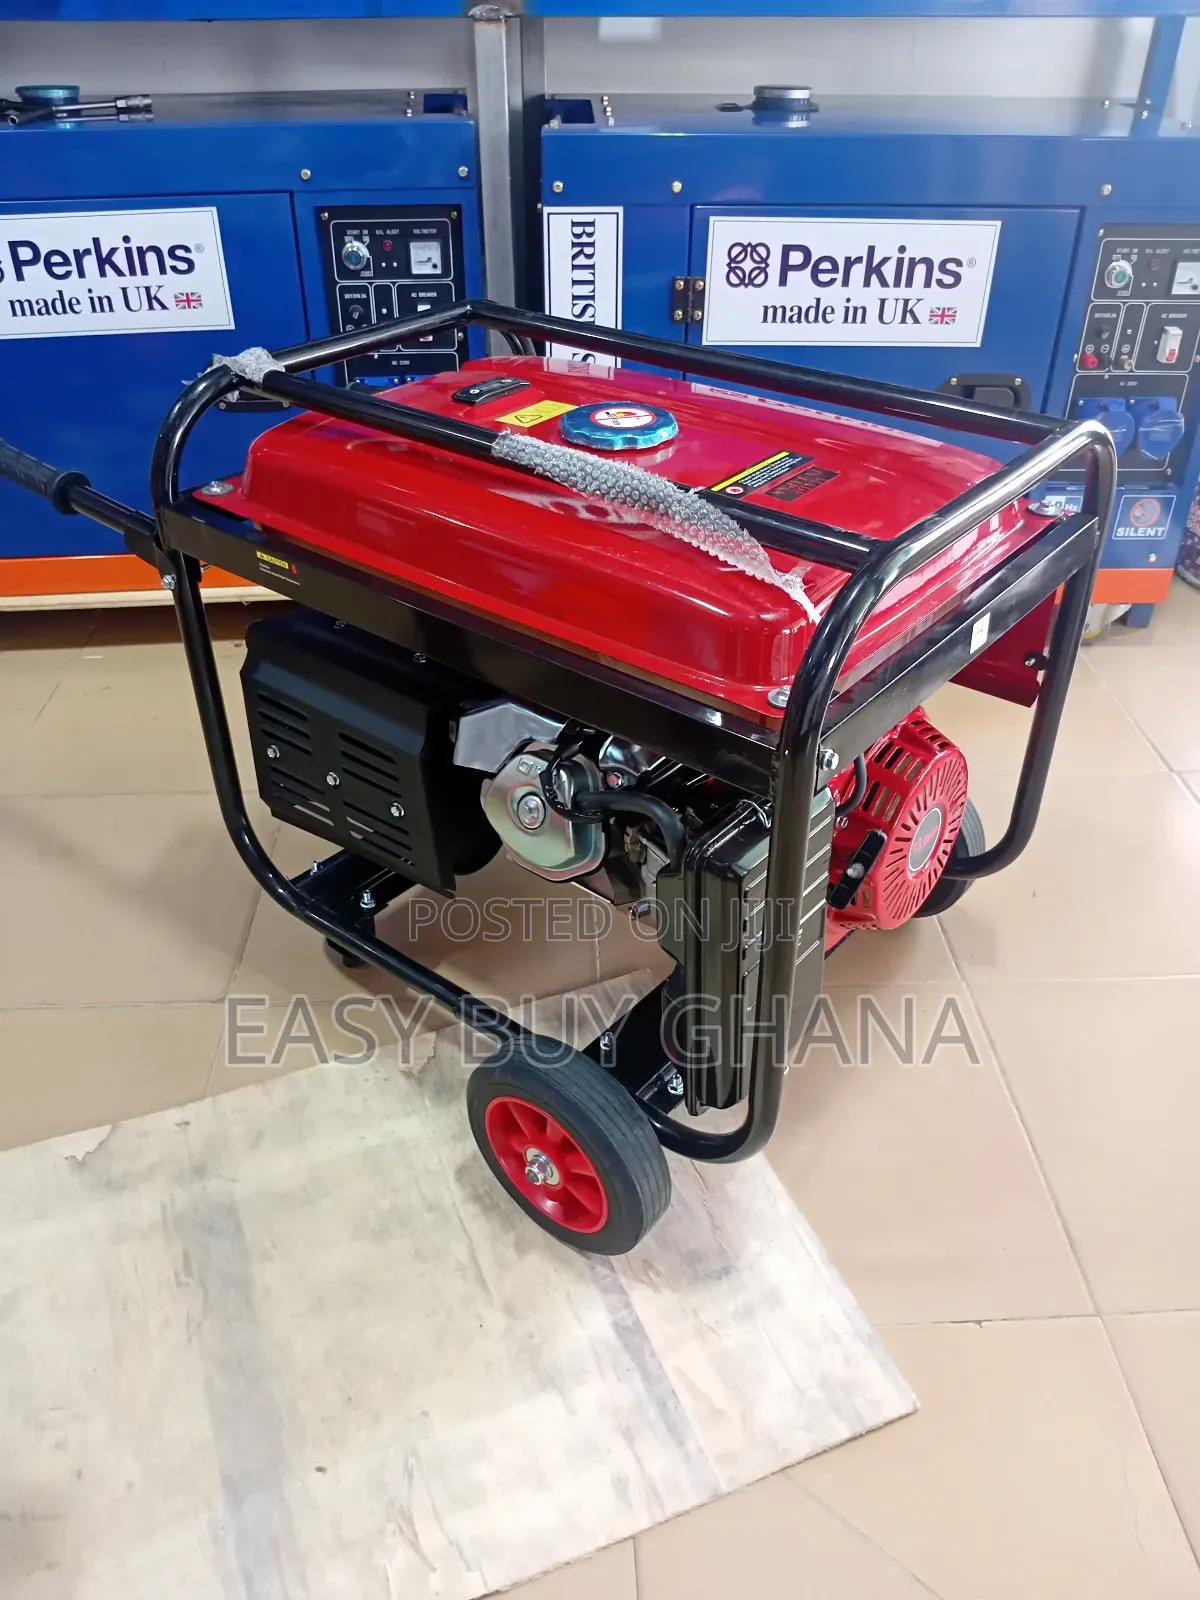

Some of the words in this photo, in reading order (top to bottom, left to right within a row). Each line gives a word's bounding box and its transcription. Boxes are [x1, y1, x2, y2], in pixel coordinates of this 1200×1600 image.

[7, 235, 196, 282] Perkins
[571, 219, 596, 325] BRITIS
[778, 244, 964, 290] Perkins
[8, 290, 83, 318] made
[88, 288, 116, 313] in
[119, 285, 170, 313] UK
[760, 297, 835, 325] made
[841, 297, 868, 325] in
[877, 297, 925, 325] UK
[1115, 527, 1166, 537] SILENT
